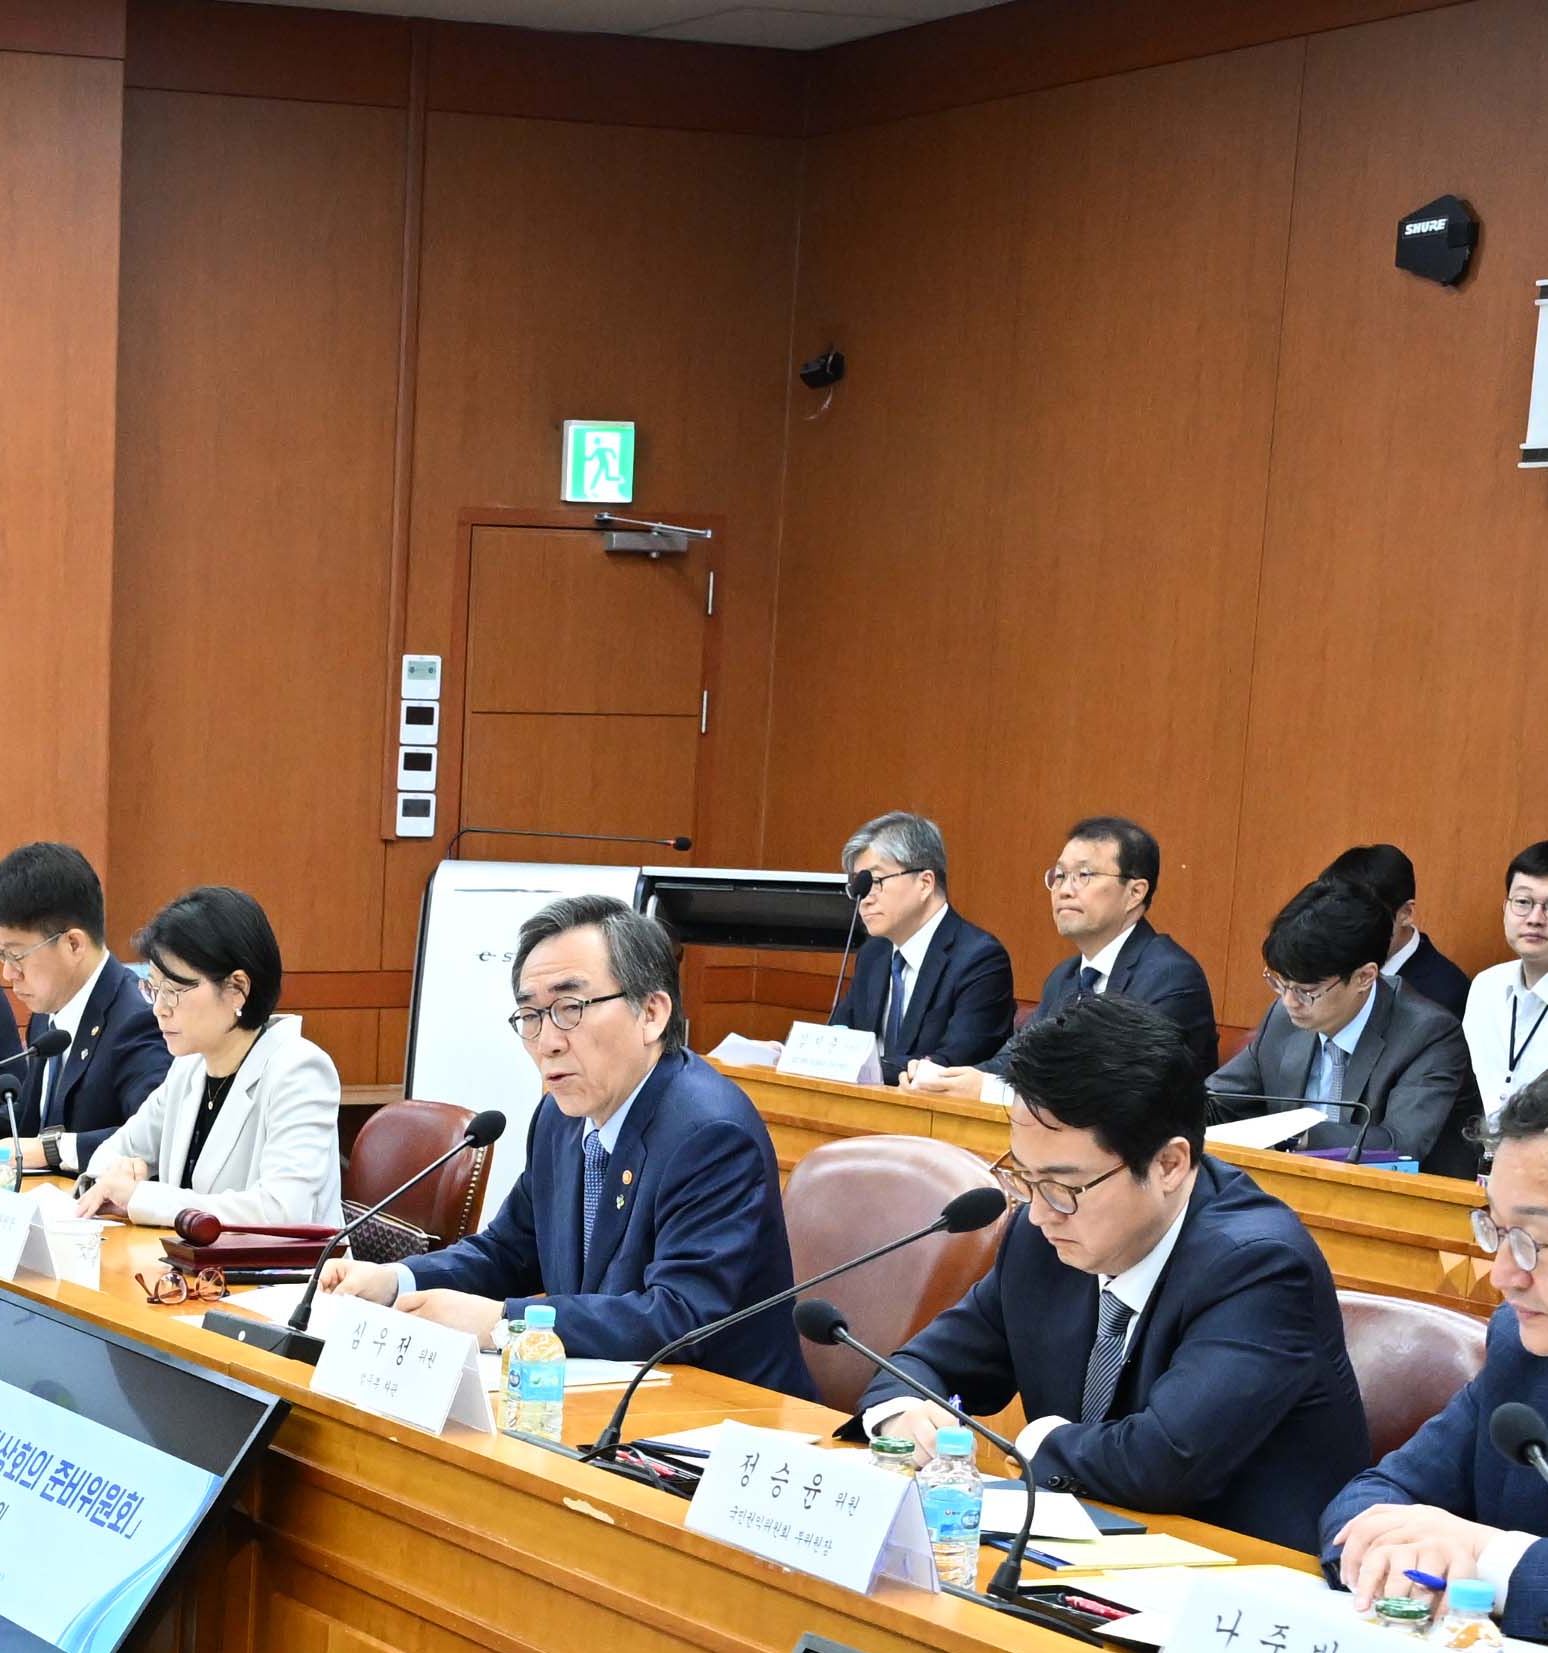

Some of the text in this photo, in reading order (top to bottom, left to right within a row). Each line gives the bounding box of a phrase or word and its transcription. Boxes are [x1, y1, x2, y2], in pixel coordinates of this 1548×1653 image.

[351, 1321, 438, 1369] 심우정 위원
[738, 1451, 861, 1517] 정승윤 위원
[728, 1504, 834, 1558] 국민권익위원회 부위원장
